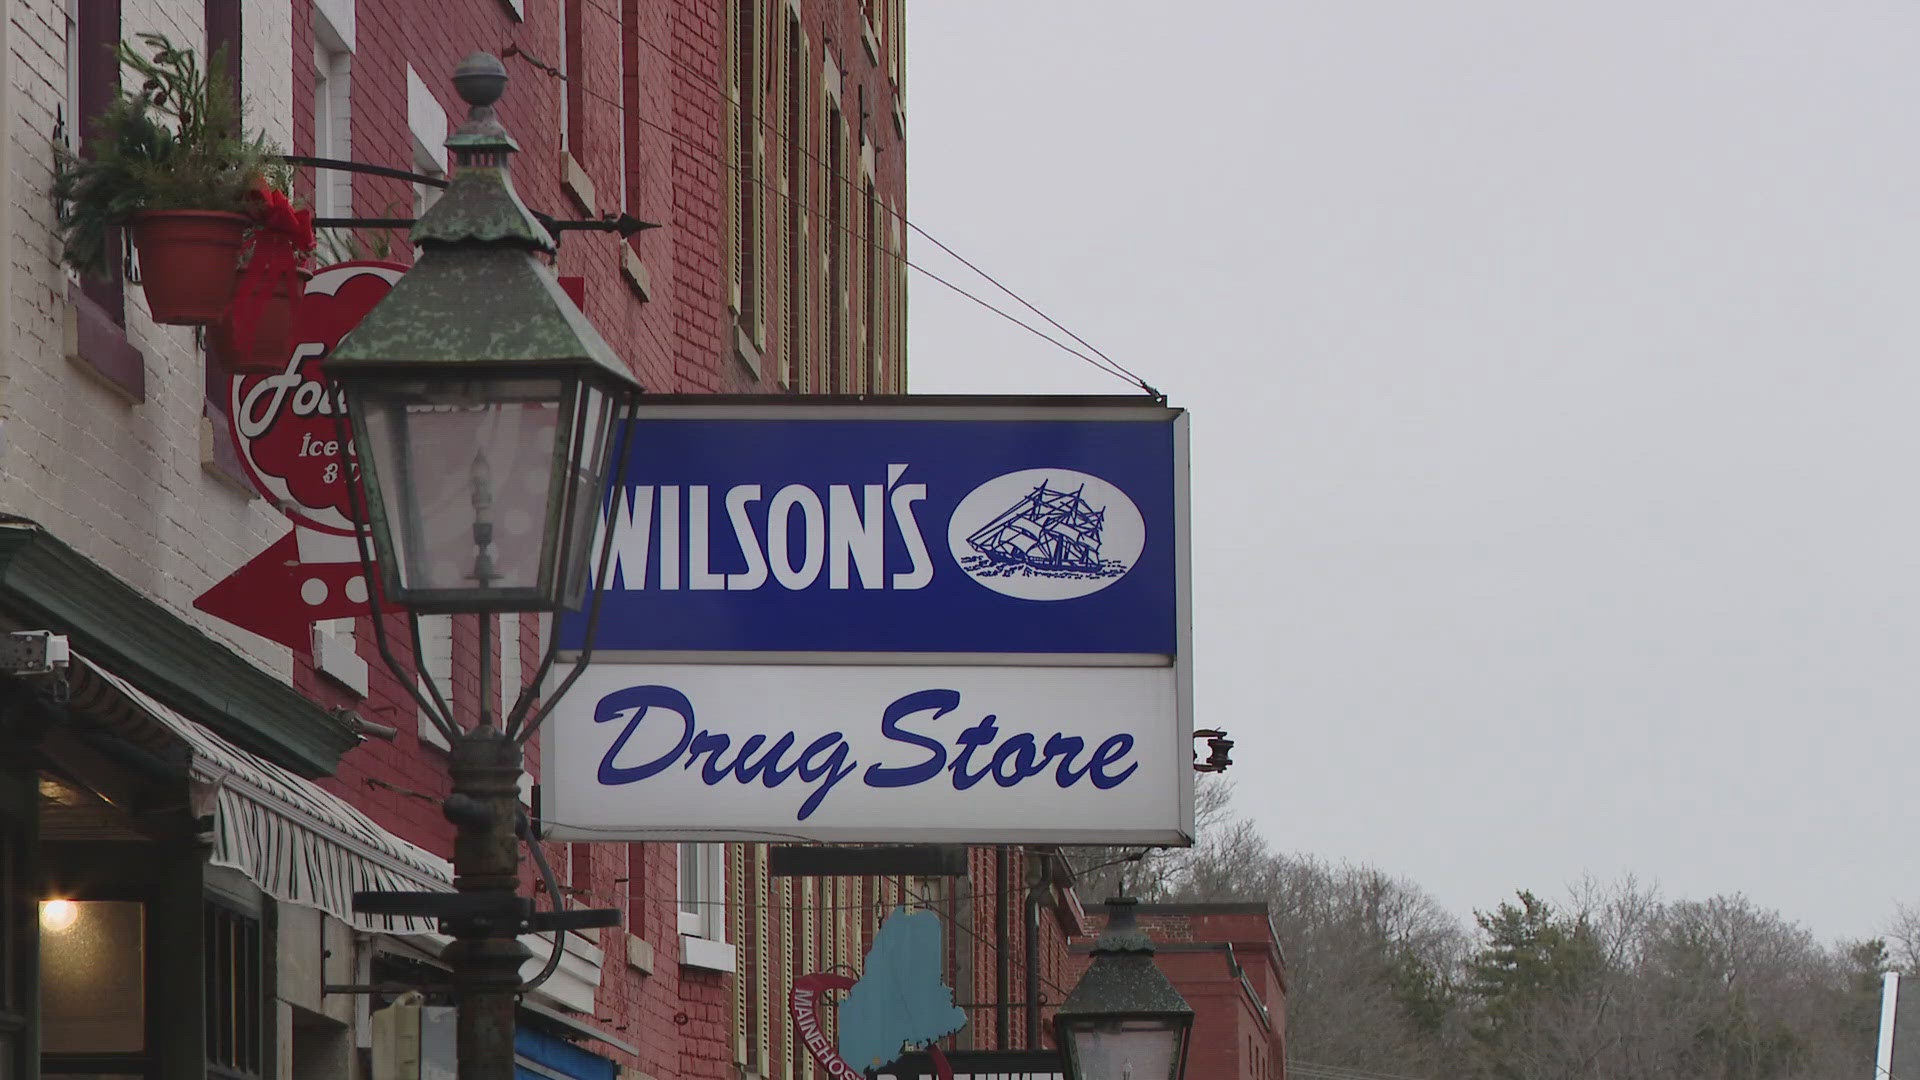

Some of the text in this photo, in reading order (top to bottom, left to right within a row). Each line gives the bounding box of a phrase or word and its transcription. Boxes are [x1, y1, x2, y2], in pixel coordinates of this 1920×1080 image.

[590, 463, 934, 591] WILSON'S
[593, 684, 1139, 821] Drug Store
[794, 987, 866, 1080] MAINEHOS
